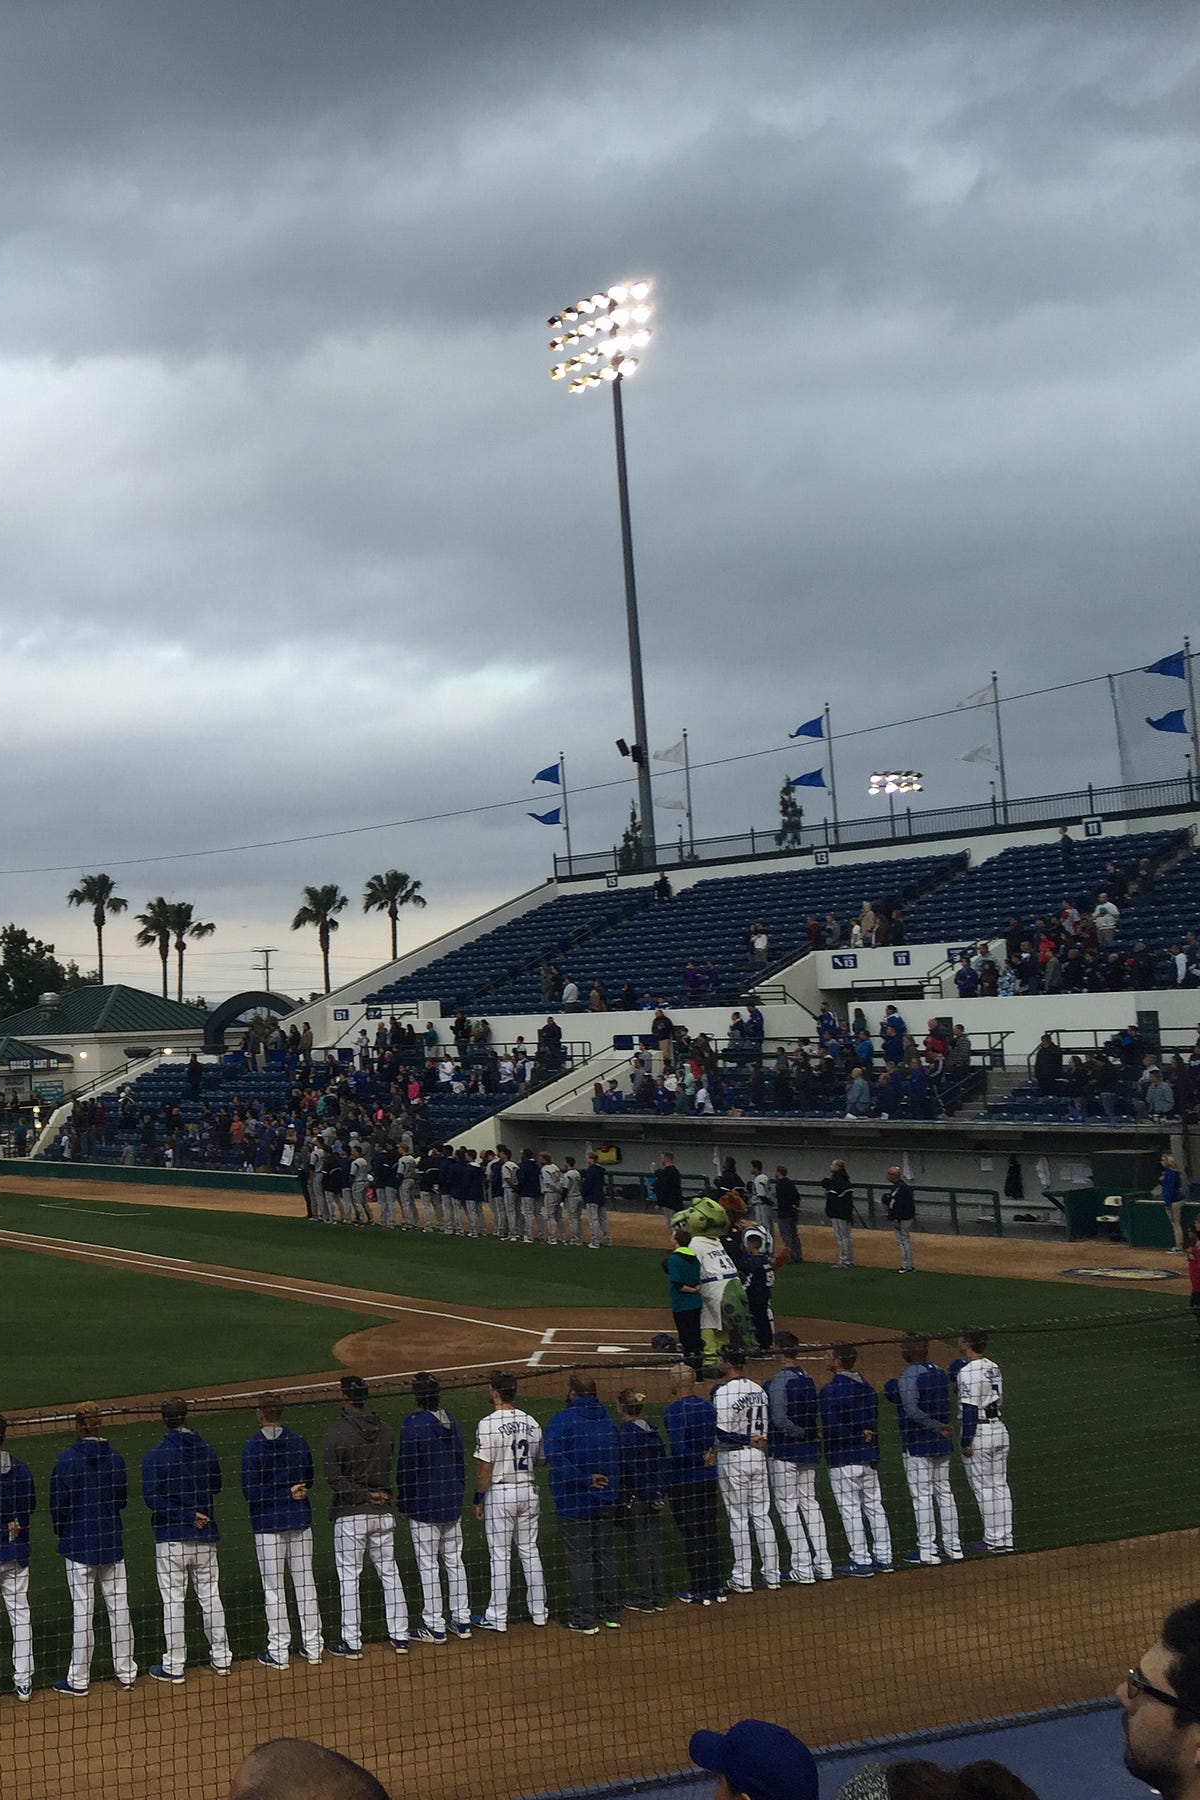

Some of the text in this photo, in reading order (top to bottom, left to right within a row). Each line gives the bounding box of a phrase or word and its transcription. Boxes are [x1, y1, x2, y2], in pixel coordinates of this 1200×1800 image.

[816, 852, 827, 863] 13
[844, 959, 854, 968] 13
[746, 1406, 765, 1437] 14
[511, 1439, 529, 1471] 12
